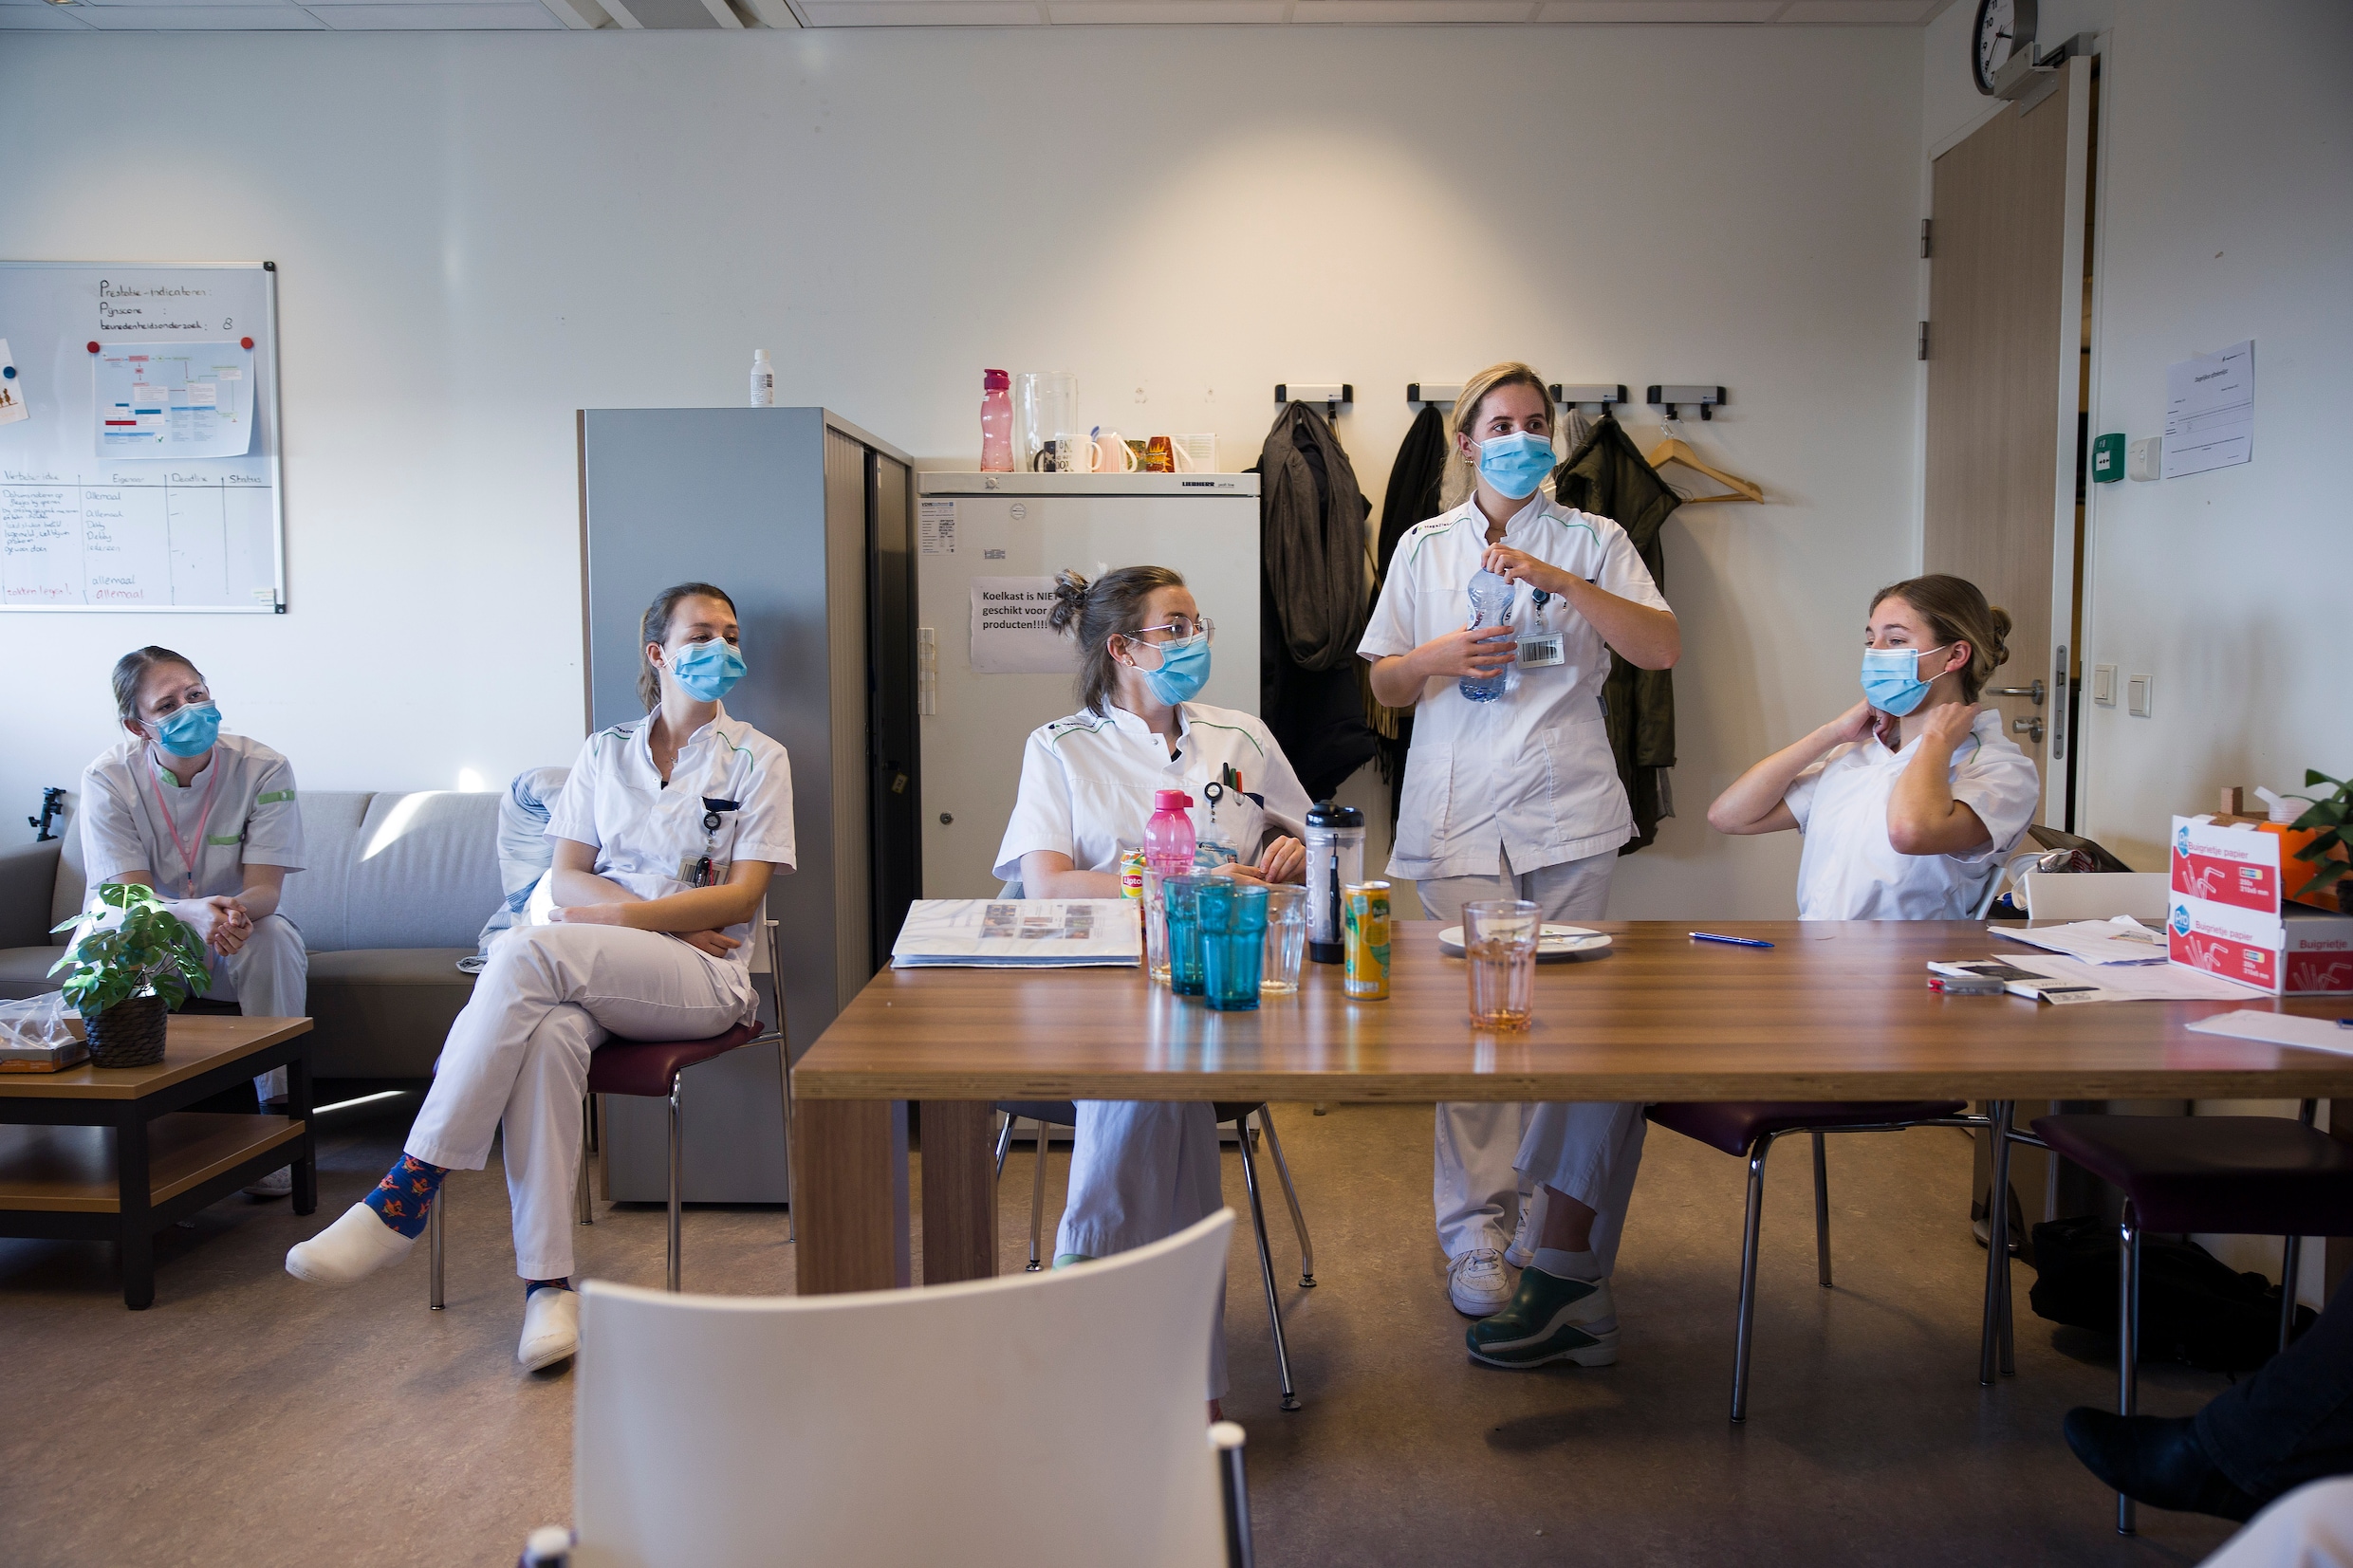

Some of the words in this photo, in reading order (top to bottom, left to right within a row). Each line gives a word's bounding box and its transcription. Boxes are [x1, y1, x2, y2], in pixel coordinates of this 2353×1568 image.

[1985, 17, 1993, 28] 10
[1983, 42, 1988, 51] 9
[223, 318, 233, 330] 8
[230, 474, 262, 483] Status
[92, 575, 136, 585] allemaal
[983, 591, 1024, 600] Koelkast
[1027, 592, 1034, 600] is
[1037, 592, 1058, 600] NIET
[982, 606, 1023, 617] geschikt
[983, 619, 1047, 630] producten!!!!
[2189, 842, 2221, 856] Buigrietje
[2224, 849, 2249, 859] papier
[1123, 876, 1142, 886] Lipto
[2176, 911, 2188, 925] Pro
[2196, 920, 2227, 935] Buigrietje
[2230, 931, 2253, 941] papier
[2300, 939, 2348, 950] Buigrietje
